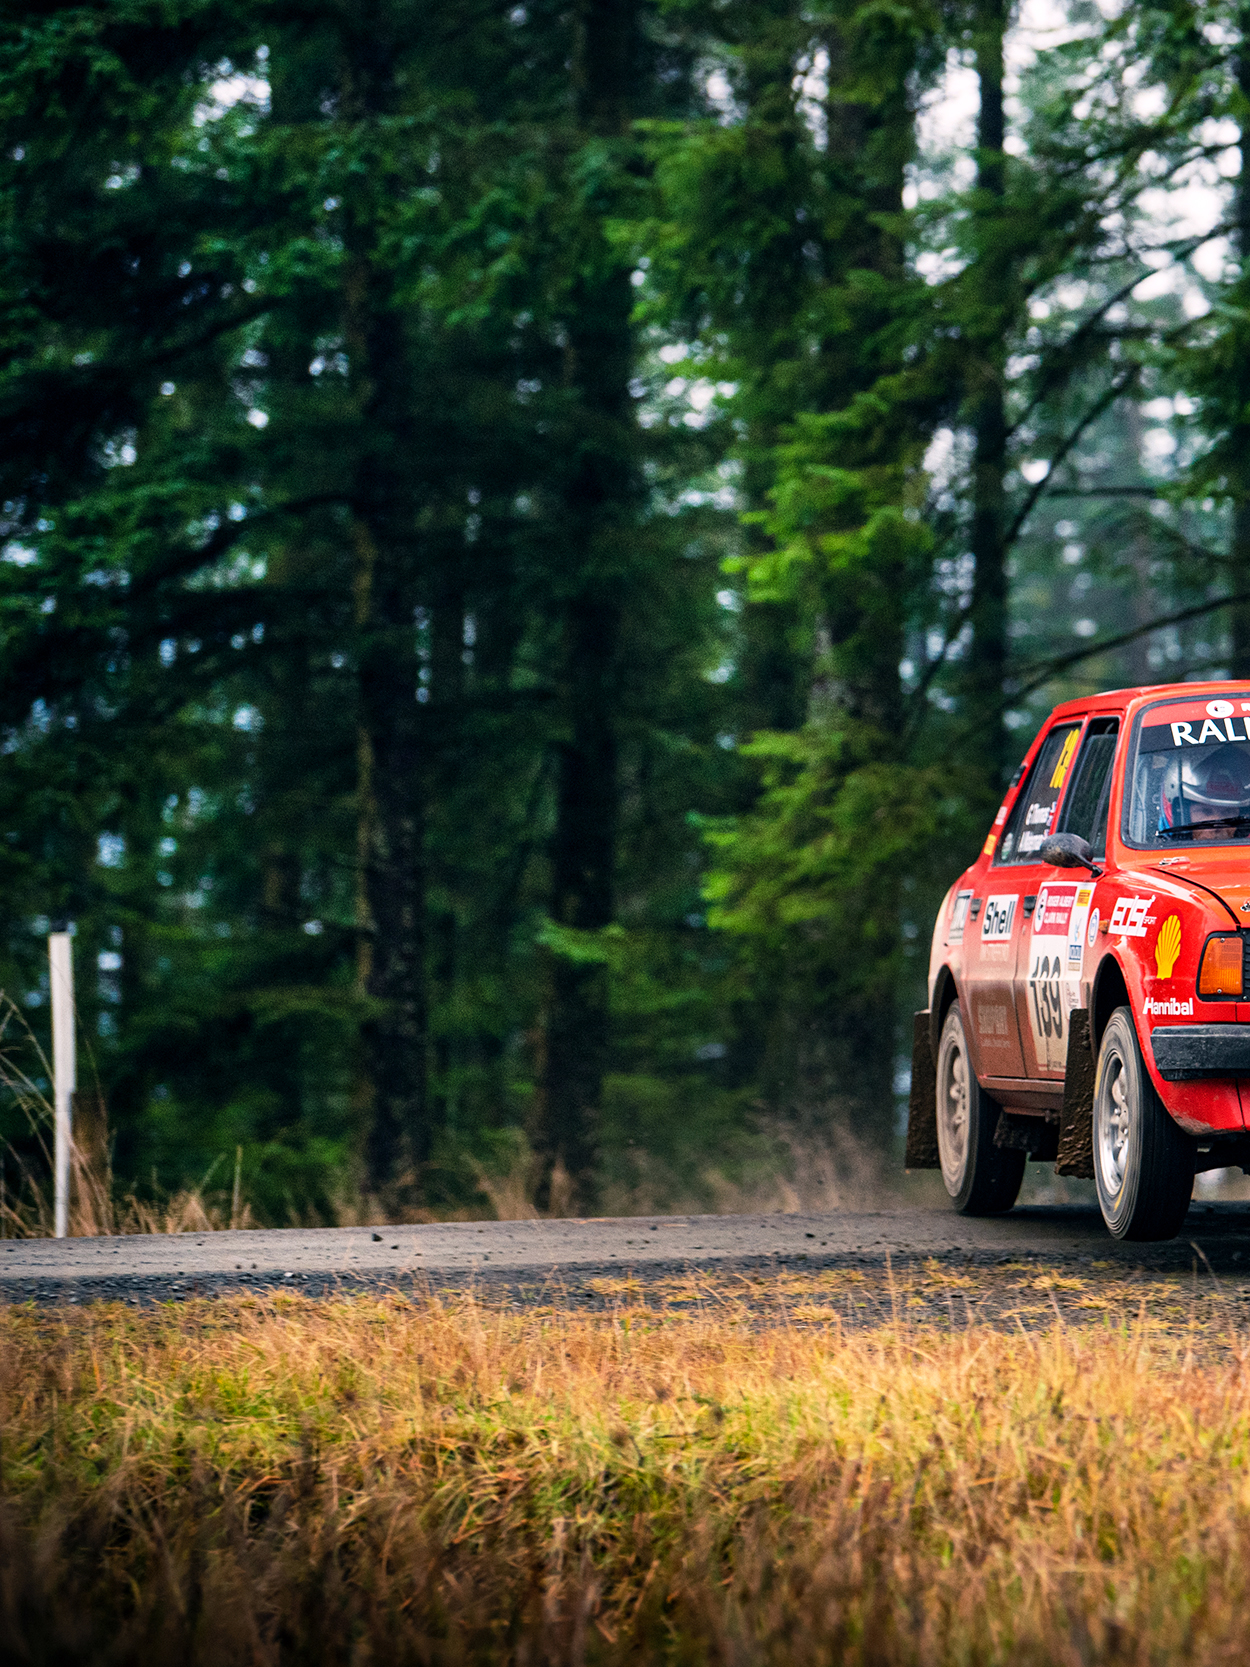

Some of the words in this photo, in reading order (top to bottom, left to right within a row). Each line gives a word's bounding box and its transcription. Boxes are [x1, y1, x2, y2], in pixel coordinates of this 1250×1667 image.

[983, 901, 1016, 935] Shell
[1030, 955, 1063, 1040] 139
[1142, 996, 1194, 1016] Hannibal
